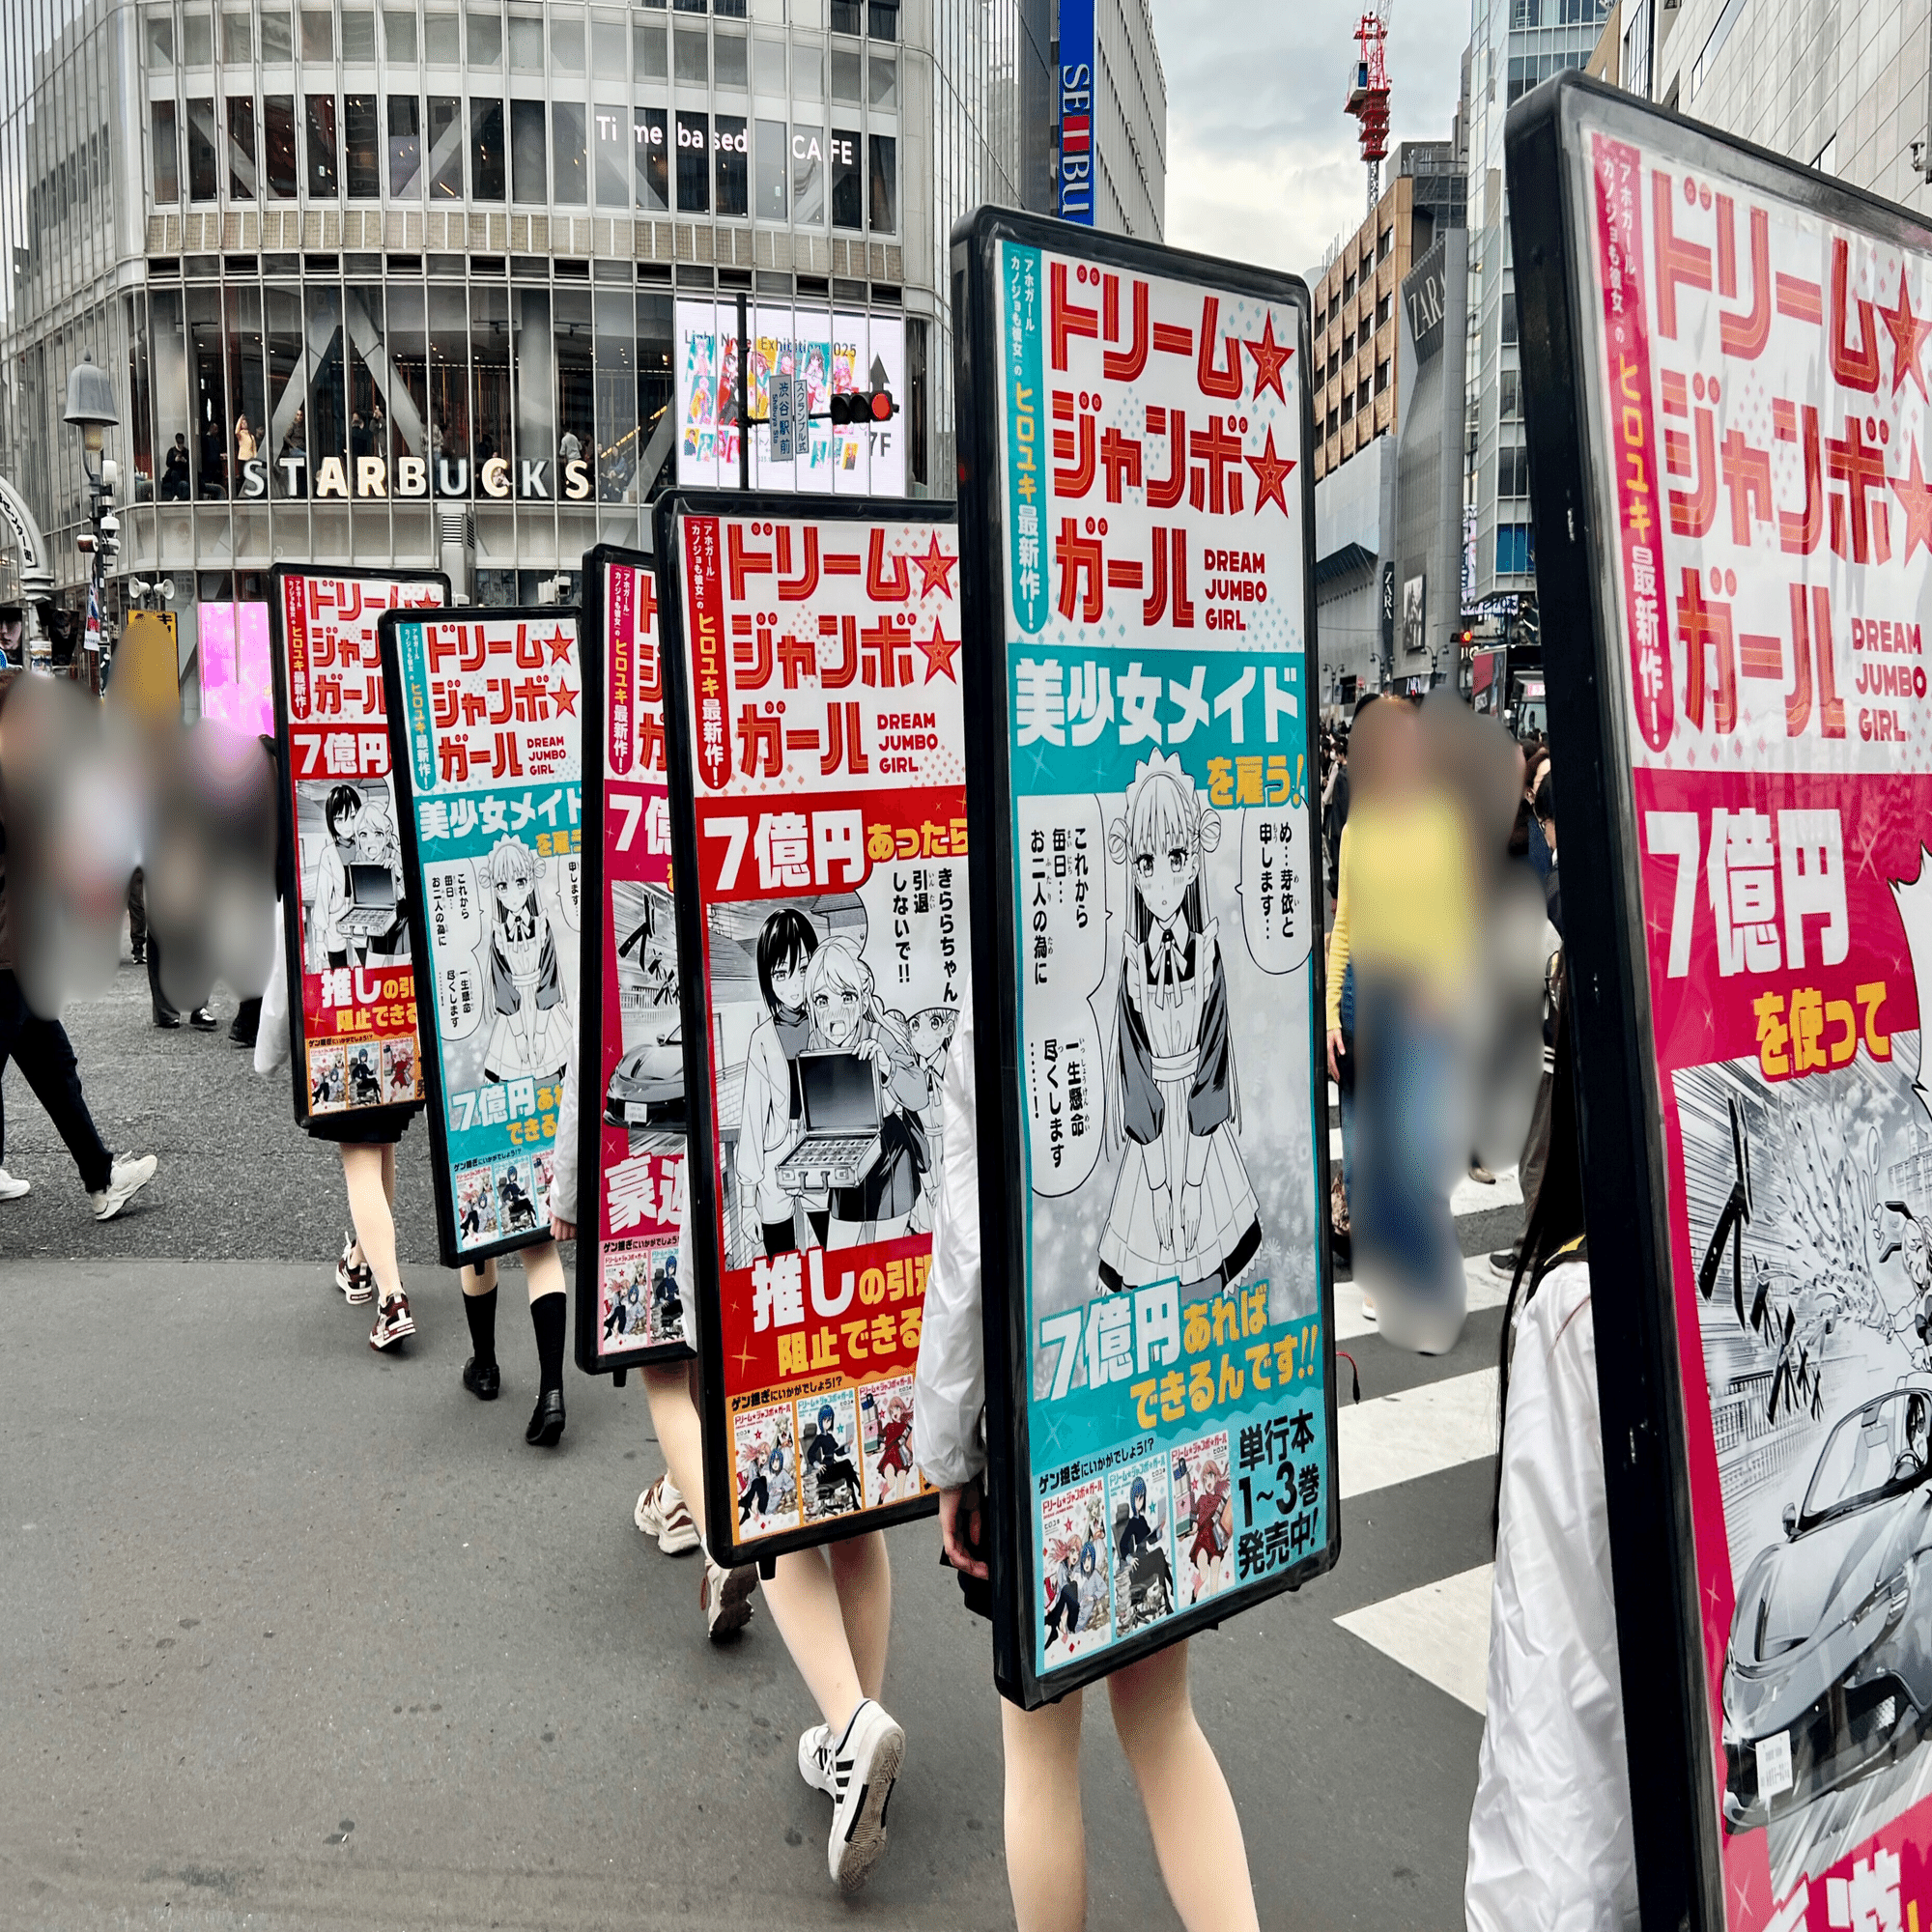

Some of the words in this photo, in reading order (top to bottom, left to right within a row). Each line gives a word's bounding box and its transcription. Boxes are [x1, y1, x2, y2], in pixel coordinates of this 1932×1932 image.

[677, 122, 748, 153] based
[792, 134, 853, 165] CAFE
[1063, 63, 1091, 214] SEIBU
[761, 337, 821, 355] Exhibition
[833, 342, 857, 356] 025
[779, 382, 790, 455] 渋谷駅前
[796, 383, 807, 452] スクランブル式
[242, 455, 589, 499] STARBUCKS
[1056, 517, 1194, 628] ガール
[1205, 549, 1264, 574] DREAM
[1206, 579, 1266, 602] JUMBO
[1206, 609, 1246, 630] GIRL
[1852, 618, 1922, 655] DREAM
[1676, 566, 1846, 739] ガール
[1015, 658, 1297, 748] 美少女メイド
[1856, 664, 1927, 698] JUMBO
[526, 736, 564, 749] DREAM
[737, 700, 868, 779] ガール
[878, 713, 936, 730] DREAM
[878, 734, 938, 751] JUMBO
[1859, 708, 1906, 742] GIRL
[294, 733, 390, 774] 7億円
[438, 731, 523, 782] ガール
[528, 750, 566, 761] JUMBO
[529, 764, 554, 776] GIRL
[879, 756, 919, 773] GIRL
[1207, 753, 1303, 809] を雇う！
[703, 810, 865, 891] 7億円
[1074, 828, 1089, 928] これから
[457, 873, 469, 919] これから
[913, 869, 928, 914] 引退
[1031, 829, 1047, 984] お二人の為に
[1645, 808, 1851, 979] 7億円
[893, 872, 911, 982] しないで!!
[938, 867, 957, 1003] きららちゃん
[1753, 981, 1891, 1076] を使って
[452, 1077, 536, 1132] 7億円
[1044, 1038, 1065, 1168] 尽くします
[1065, 1042, 1084, 1137] 一生懸命
[506, 1113, 557, 1145] できる
[778, 1307, 923, 1378] 阻止できる
[1040, 1281, 1180, 1402] 7億円
[1183, 1284, 1269, 1354] あれば
[1238, 1408, 1315, 1471] 単行本
[1238, 1507, 1319, 1580] 発売中！
